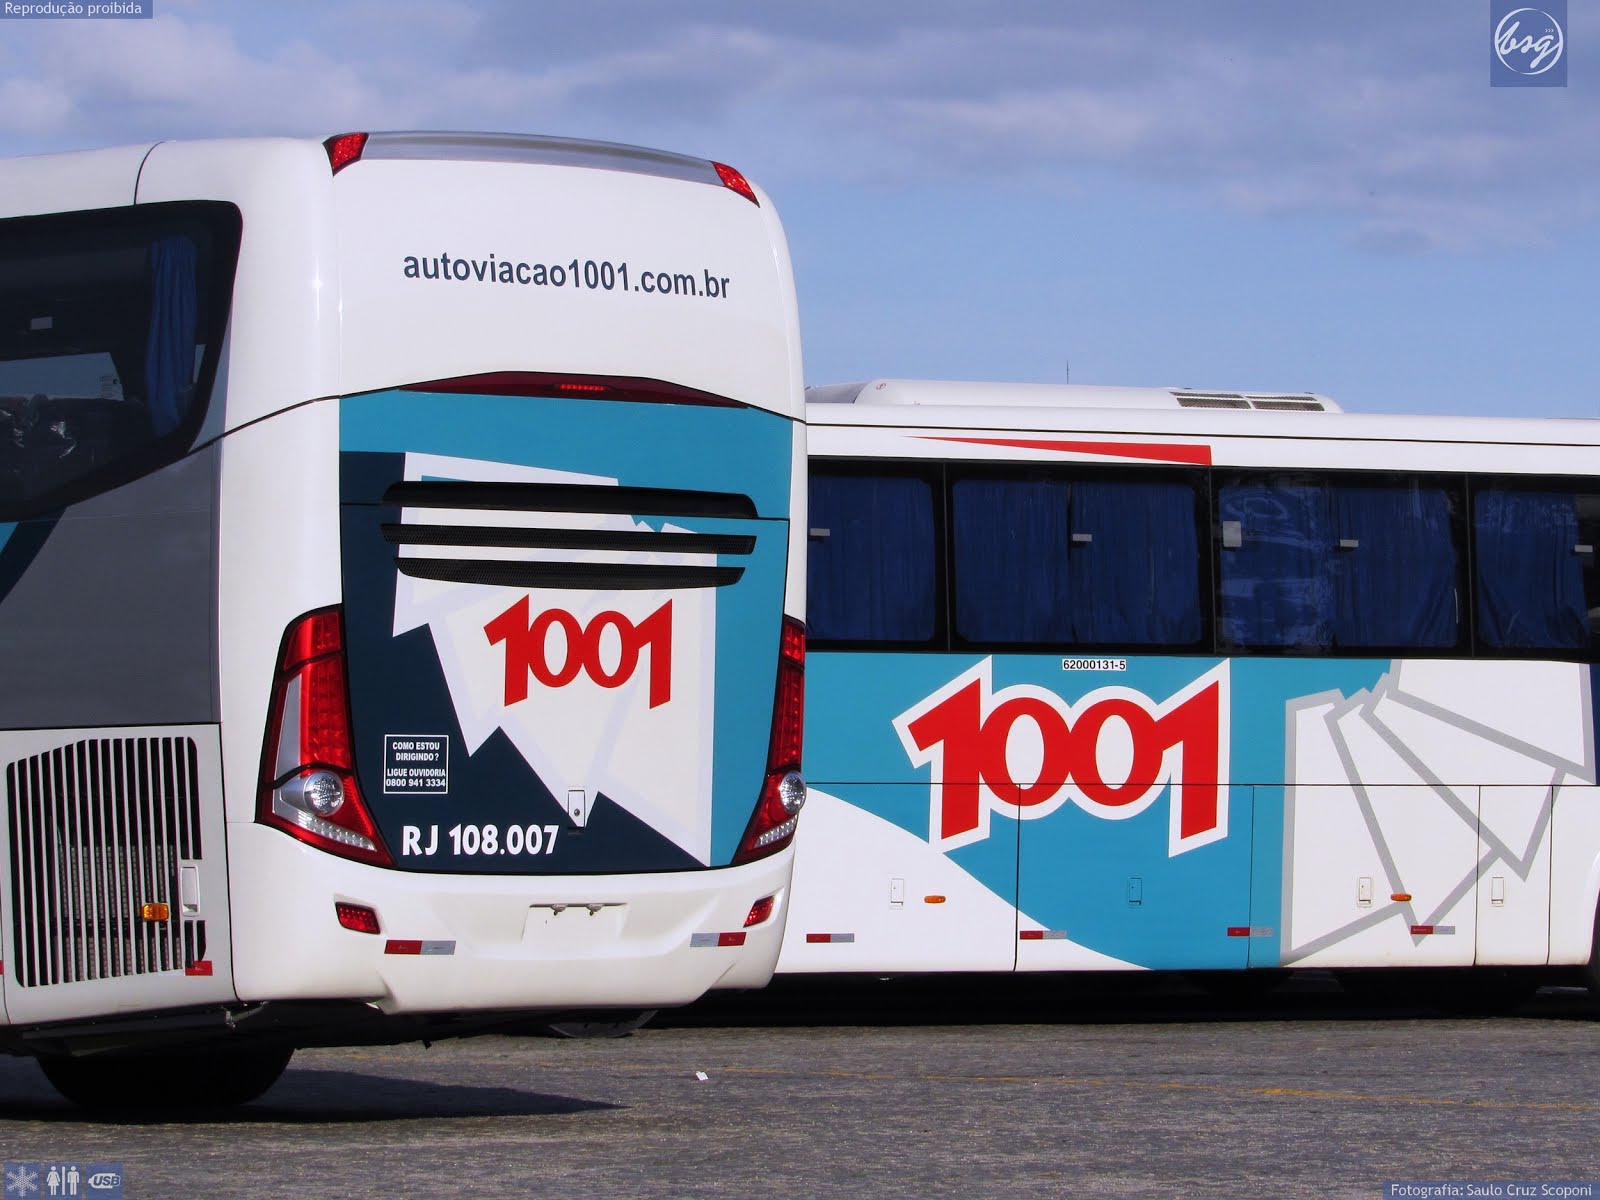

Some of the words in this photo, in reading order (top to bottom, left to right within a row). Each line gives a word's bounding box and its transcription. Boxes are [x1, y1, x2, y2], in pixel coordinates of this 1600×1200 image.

[403, 252, 730, 298] autoviacao1001.com.br
[483, 593, 673, 709] 1001
[1063, 659, 1126, 670] 62000131-5
[392, 742, 414, 750] COMO
[416, 742, 440, 750] ESTOU
[900, 666, 1225, 850] 1001
[386, 778, 407, 787] 0800
[408, 778, 423, 787] 941
[425, 778, 446, 787] 3334
[387, 768, 408, 777] LIGUE
[409, 768, 446, 777] OUVIDORIA
[402, 825, 439, 856] RJ
[449, 823, 559, 855] 108.007
